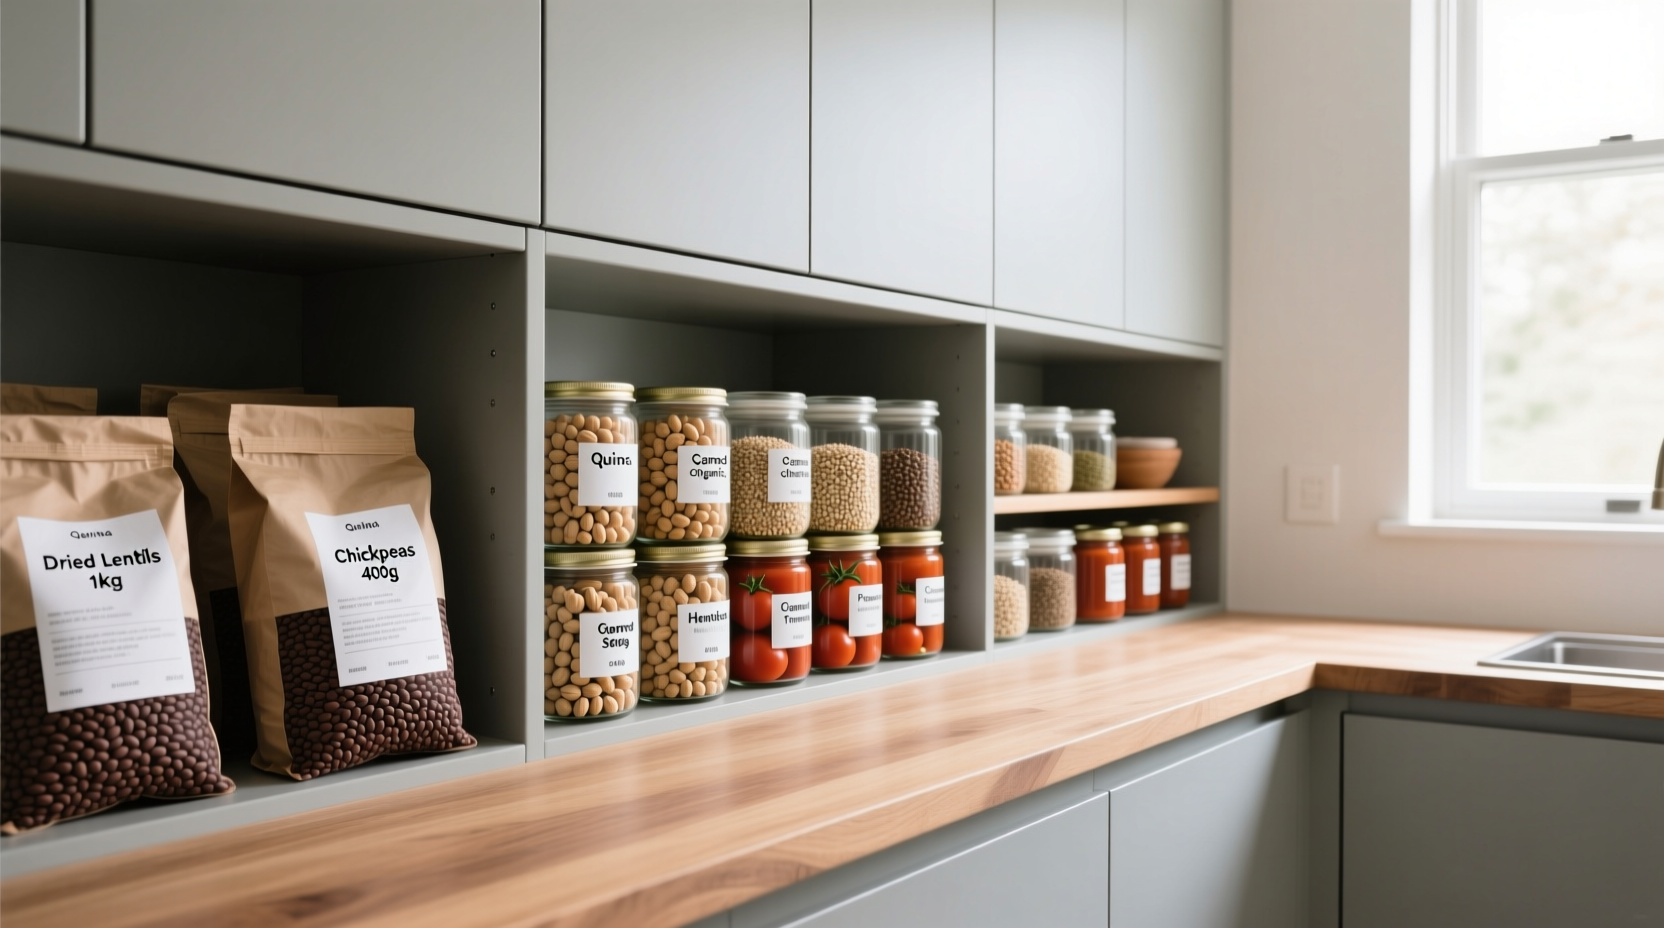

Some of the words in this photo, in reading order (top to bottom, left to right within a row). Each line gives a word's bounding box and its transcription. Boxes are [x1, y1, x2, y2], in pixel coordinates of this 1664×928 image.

[43, 553, 96, 571] Dried
[334, 544, 416, 564] Chickpeas
[89, 572, 124, 592] 1kg
[361, 565, 400, 583] 400g
